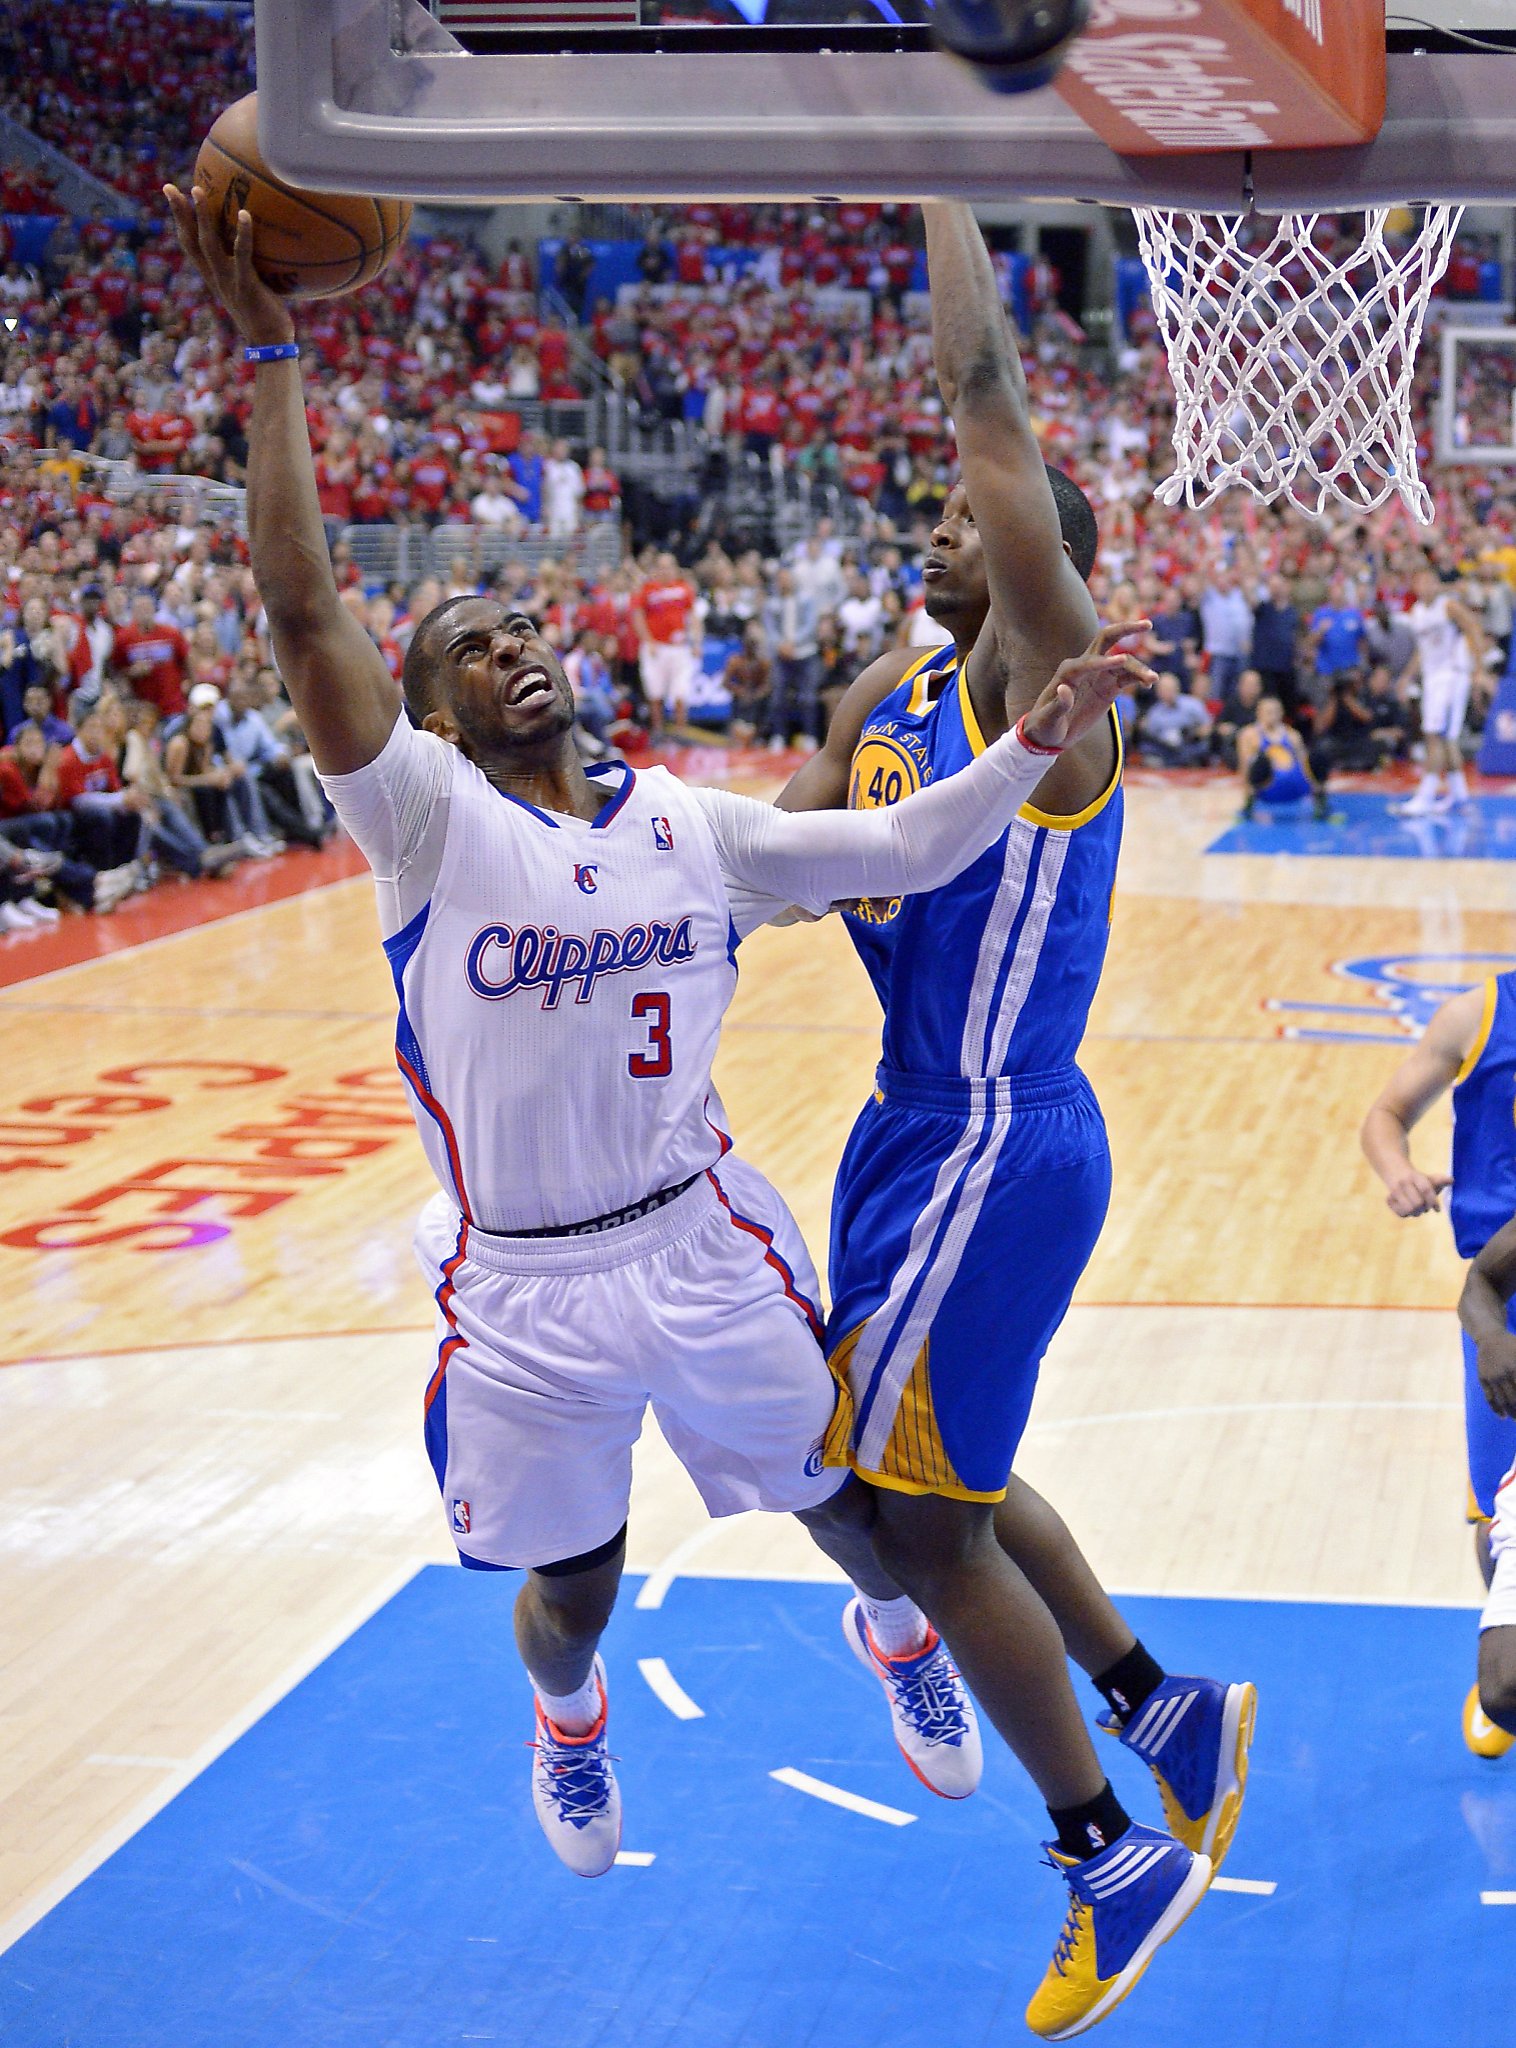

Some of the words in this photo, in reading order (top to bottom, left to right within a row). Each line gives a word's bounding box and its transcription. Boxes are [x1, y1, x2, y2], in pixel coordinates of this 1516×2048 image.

[868, 766, 902, 806] 40
[464, 916, 698, 1010] Clippers
[627, 992, 673, 1079] 3
